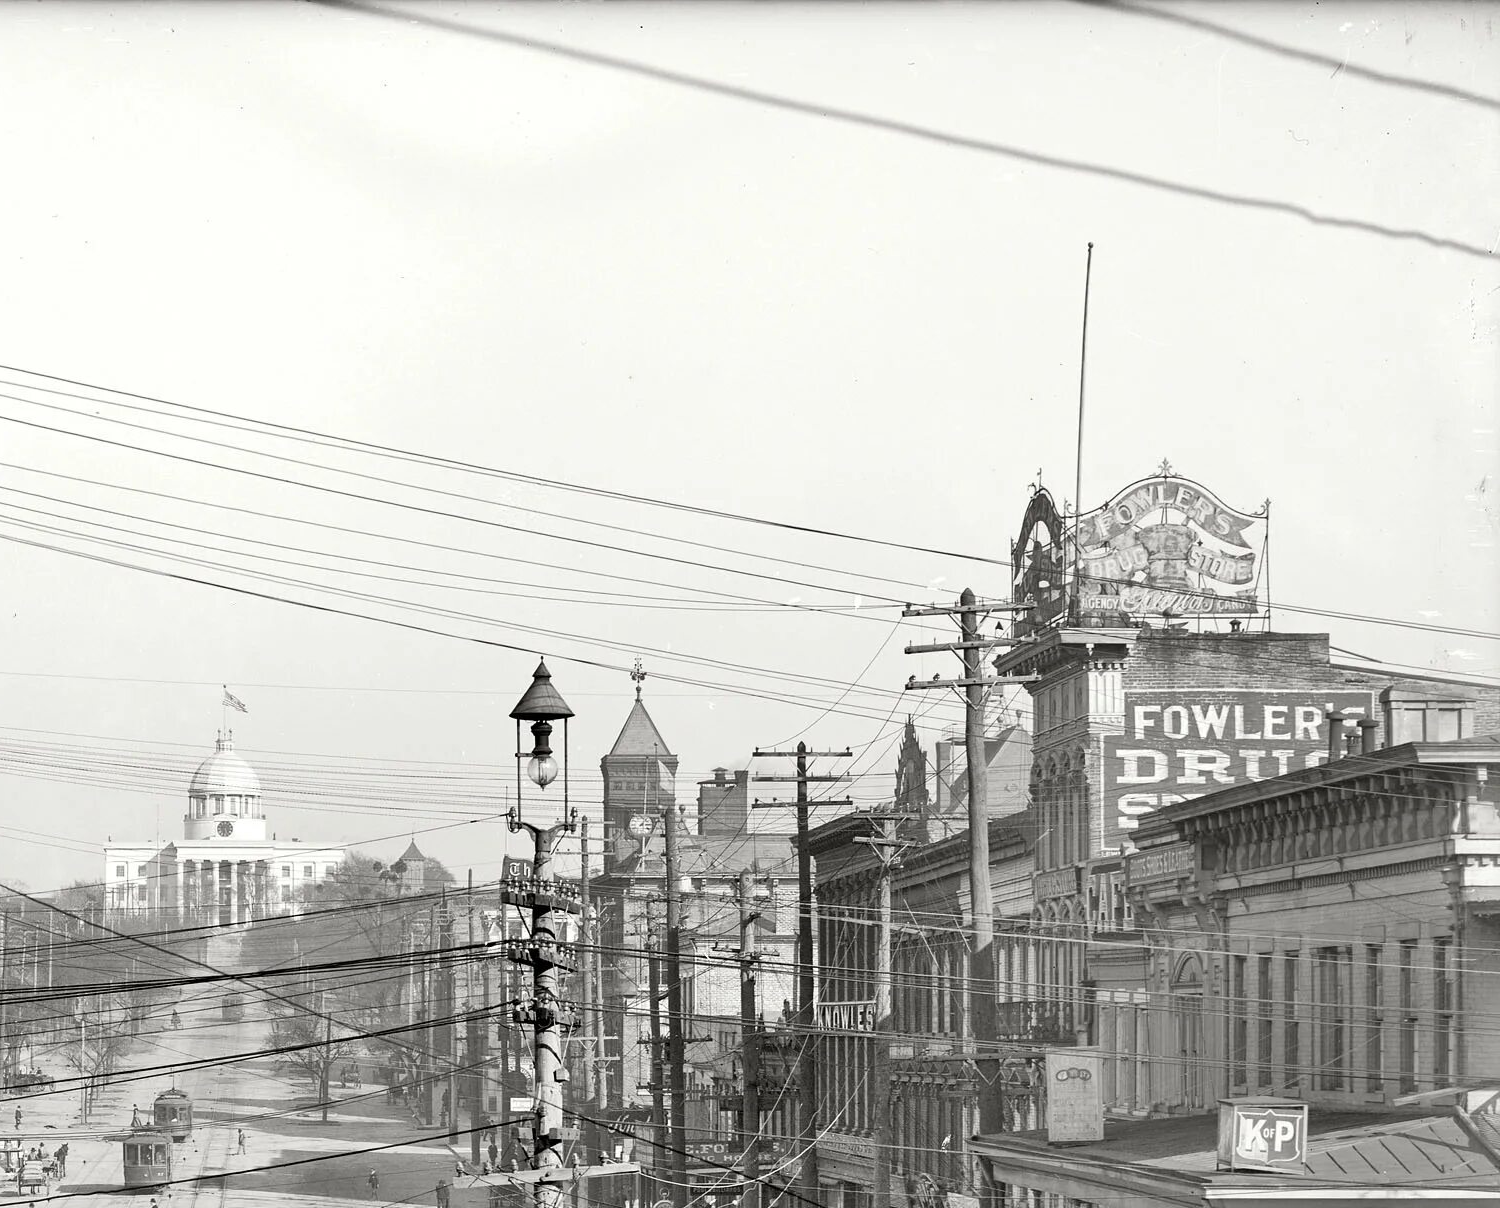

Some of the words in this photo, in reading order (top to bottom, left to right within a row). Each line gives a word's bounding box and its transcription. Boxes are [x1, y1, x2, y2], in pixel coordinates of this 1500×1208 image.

[1094, 485, 1233, 541] FOWLER'S
[1089, 546, 1148, 583] DRUG
[1134, 703, 1366, 741] FOWLER'S
[1245, 1118, 1268, 1153] K
[1262, 1127, 1276, 1139] OF
[1274, 1120, 1295, 1152] P
